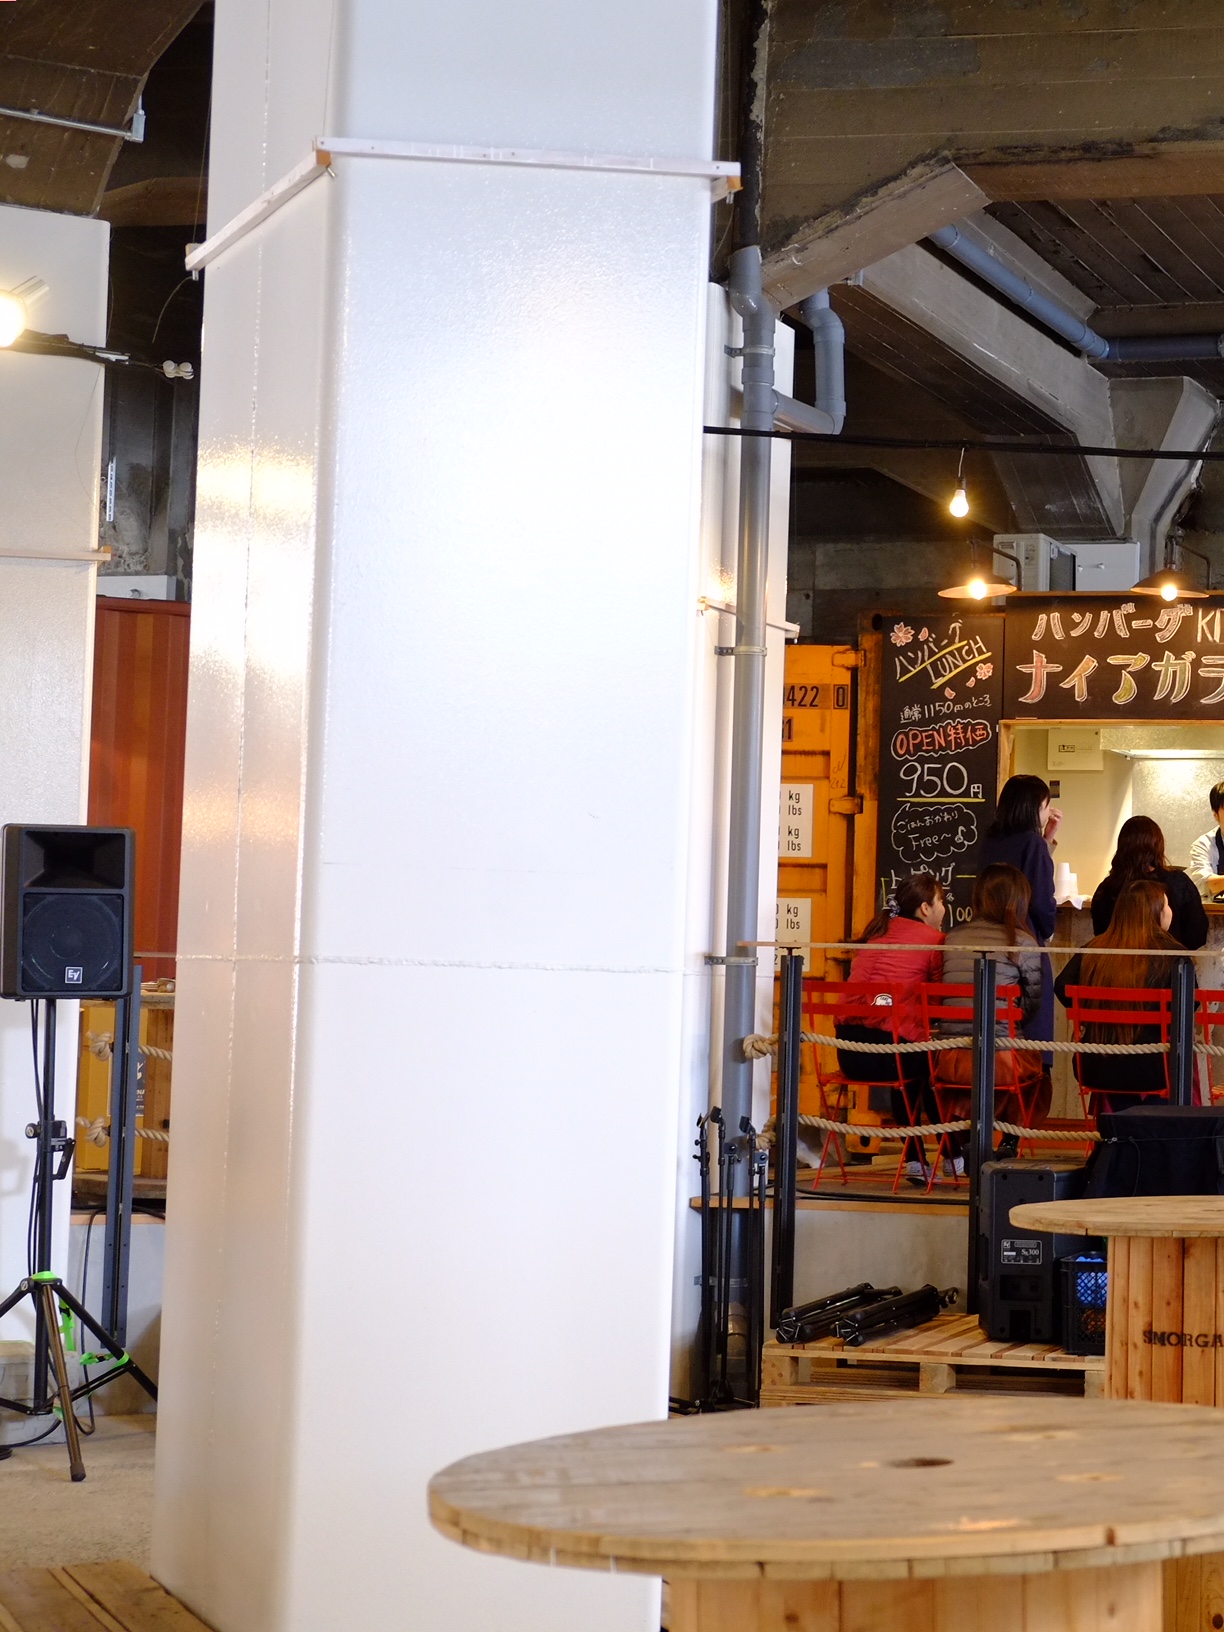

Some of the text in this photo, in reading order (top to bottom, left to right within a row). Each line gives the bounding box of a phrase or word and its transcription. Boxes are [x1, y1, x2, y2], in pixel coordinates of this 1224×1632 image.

[1031, 602, 1194, 644] ハンバーグ
[895, 618, 963, 681] ハンバーグ
[926, 635, 988, 684] LUNCH
[782, 685, 821, 708] 422
[788, 789, 801, 804] kg
[787, 804, 803, 816] lbs
[787, 825, 800, 840] kg
[786, 840, 802, 852] lbs
[786, 903, 799, 917] kg
[785, 918, 801, 930] lbs
